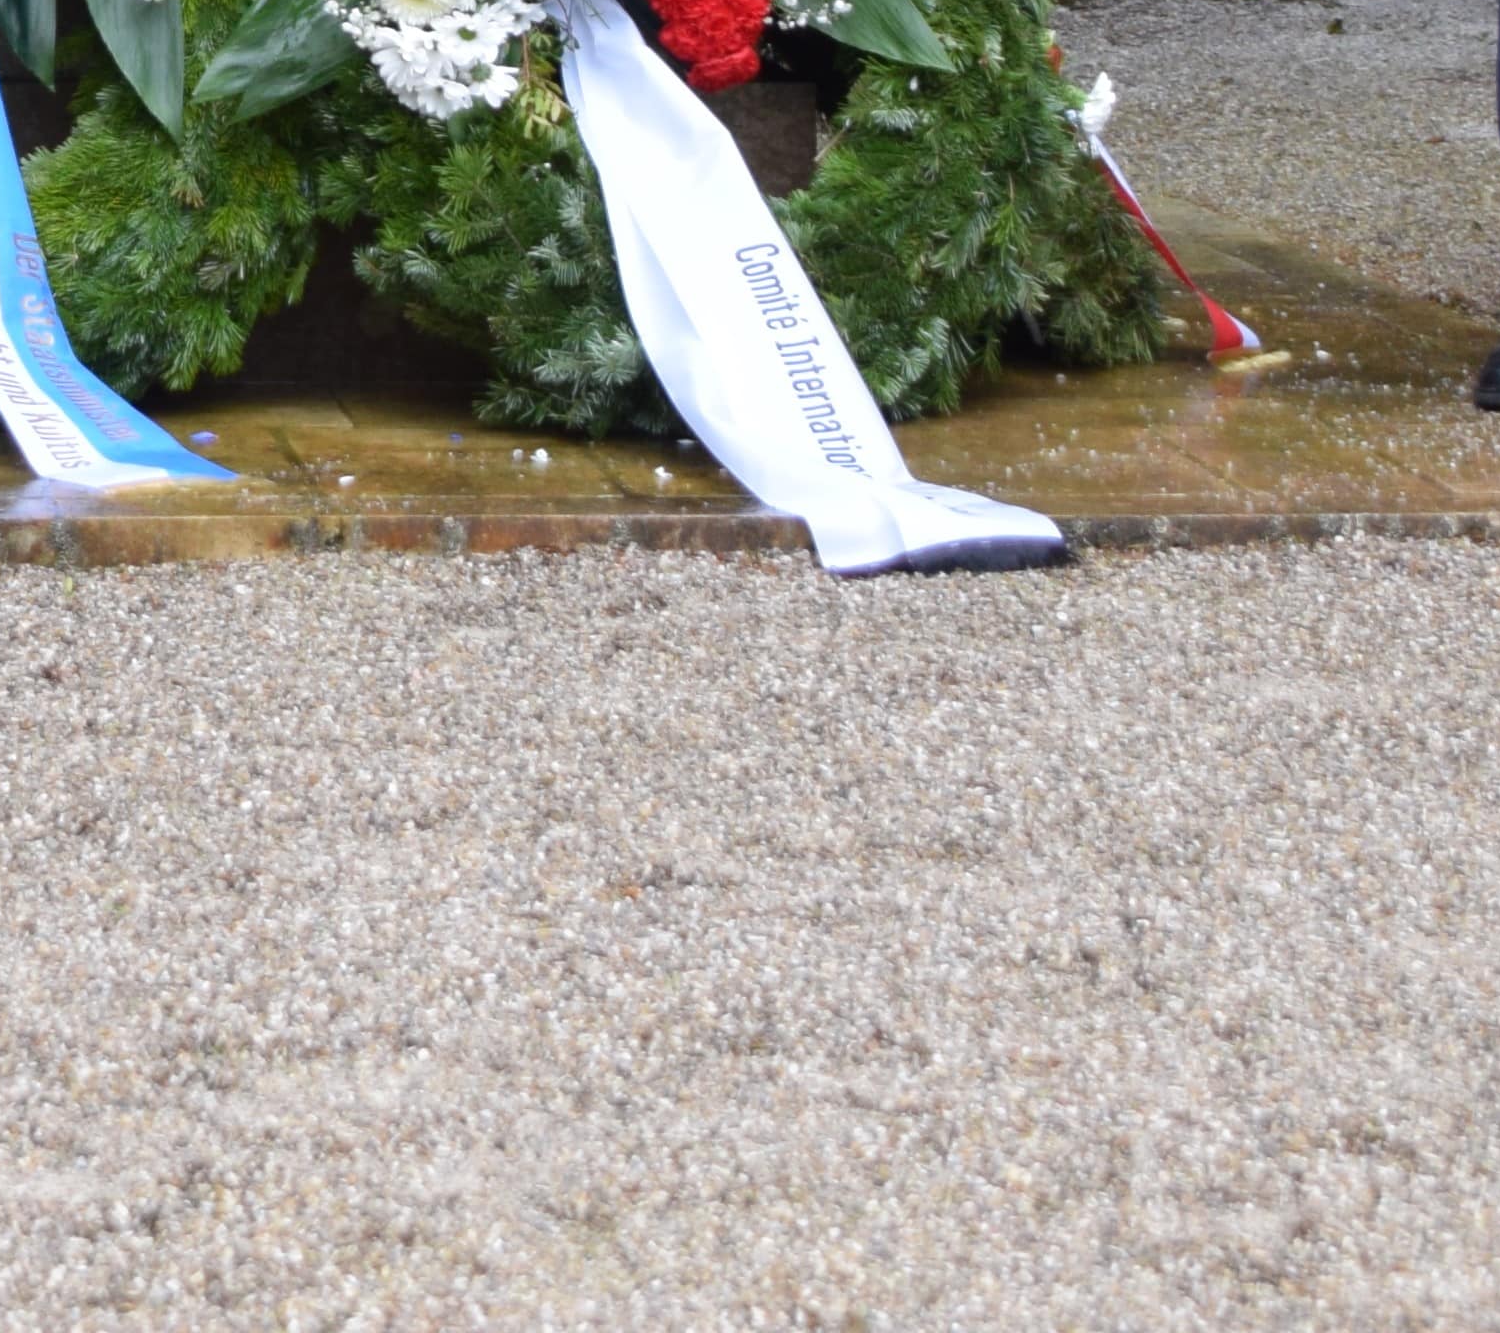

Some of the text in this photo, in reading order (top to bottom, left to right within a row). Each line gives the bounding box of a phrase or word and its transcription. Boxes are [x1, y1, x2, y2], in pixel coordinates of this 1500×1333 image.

[12, 232, 46, 282] Der
[735, 242, 809, 331] Comité
[21, 410, 92, 470] Kultus
